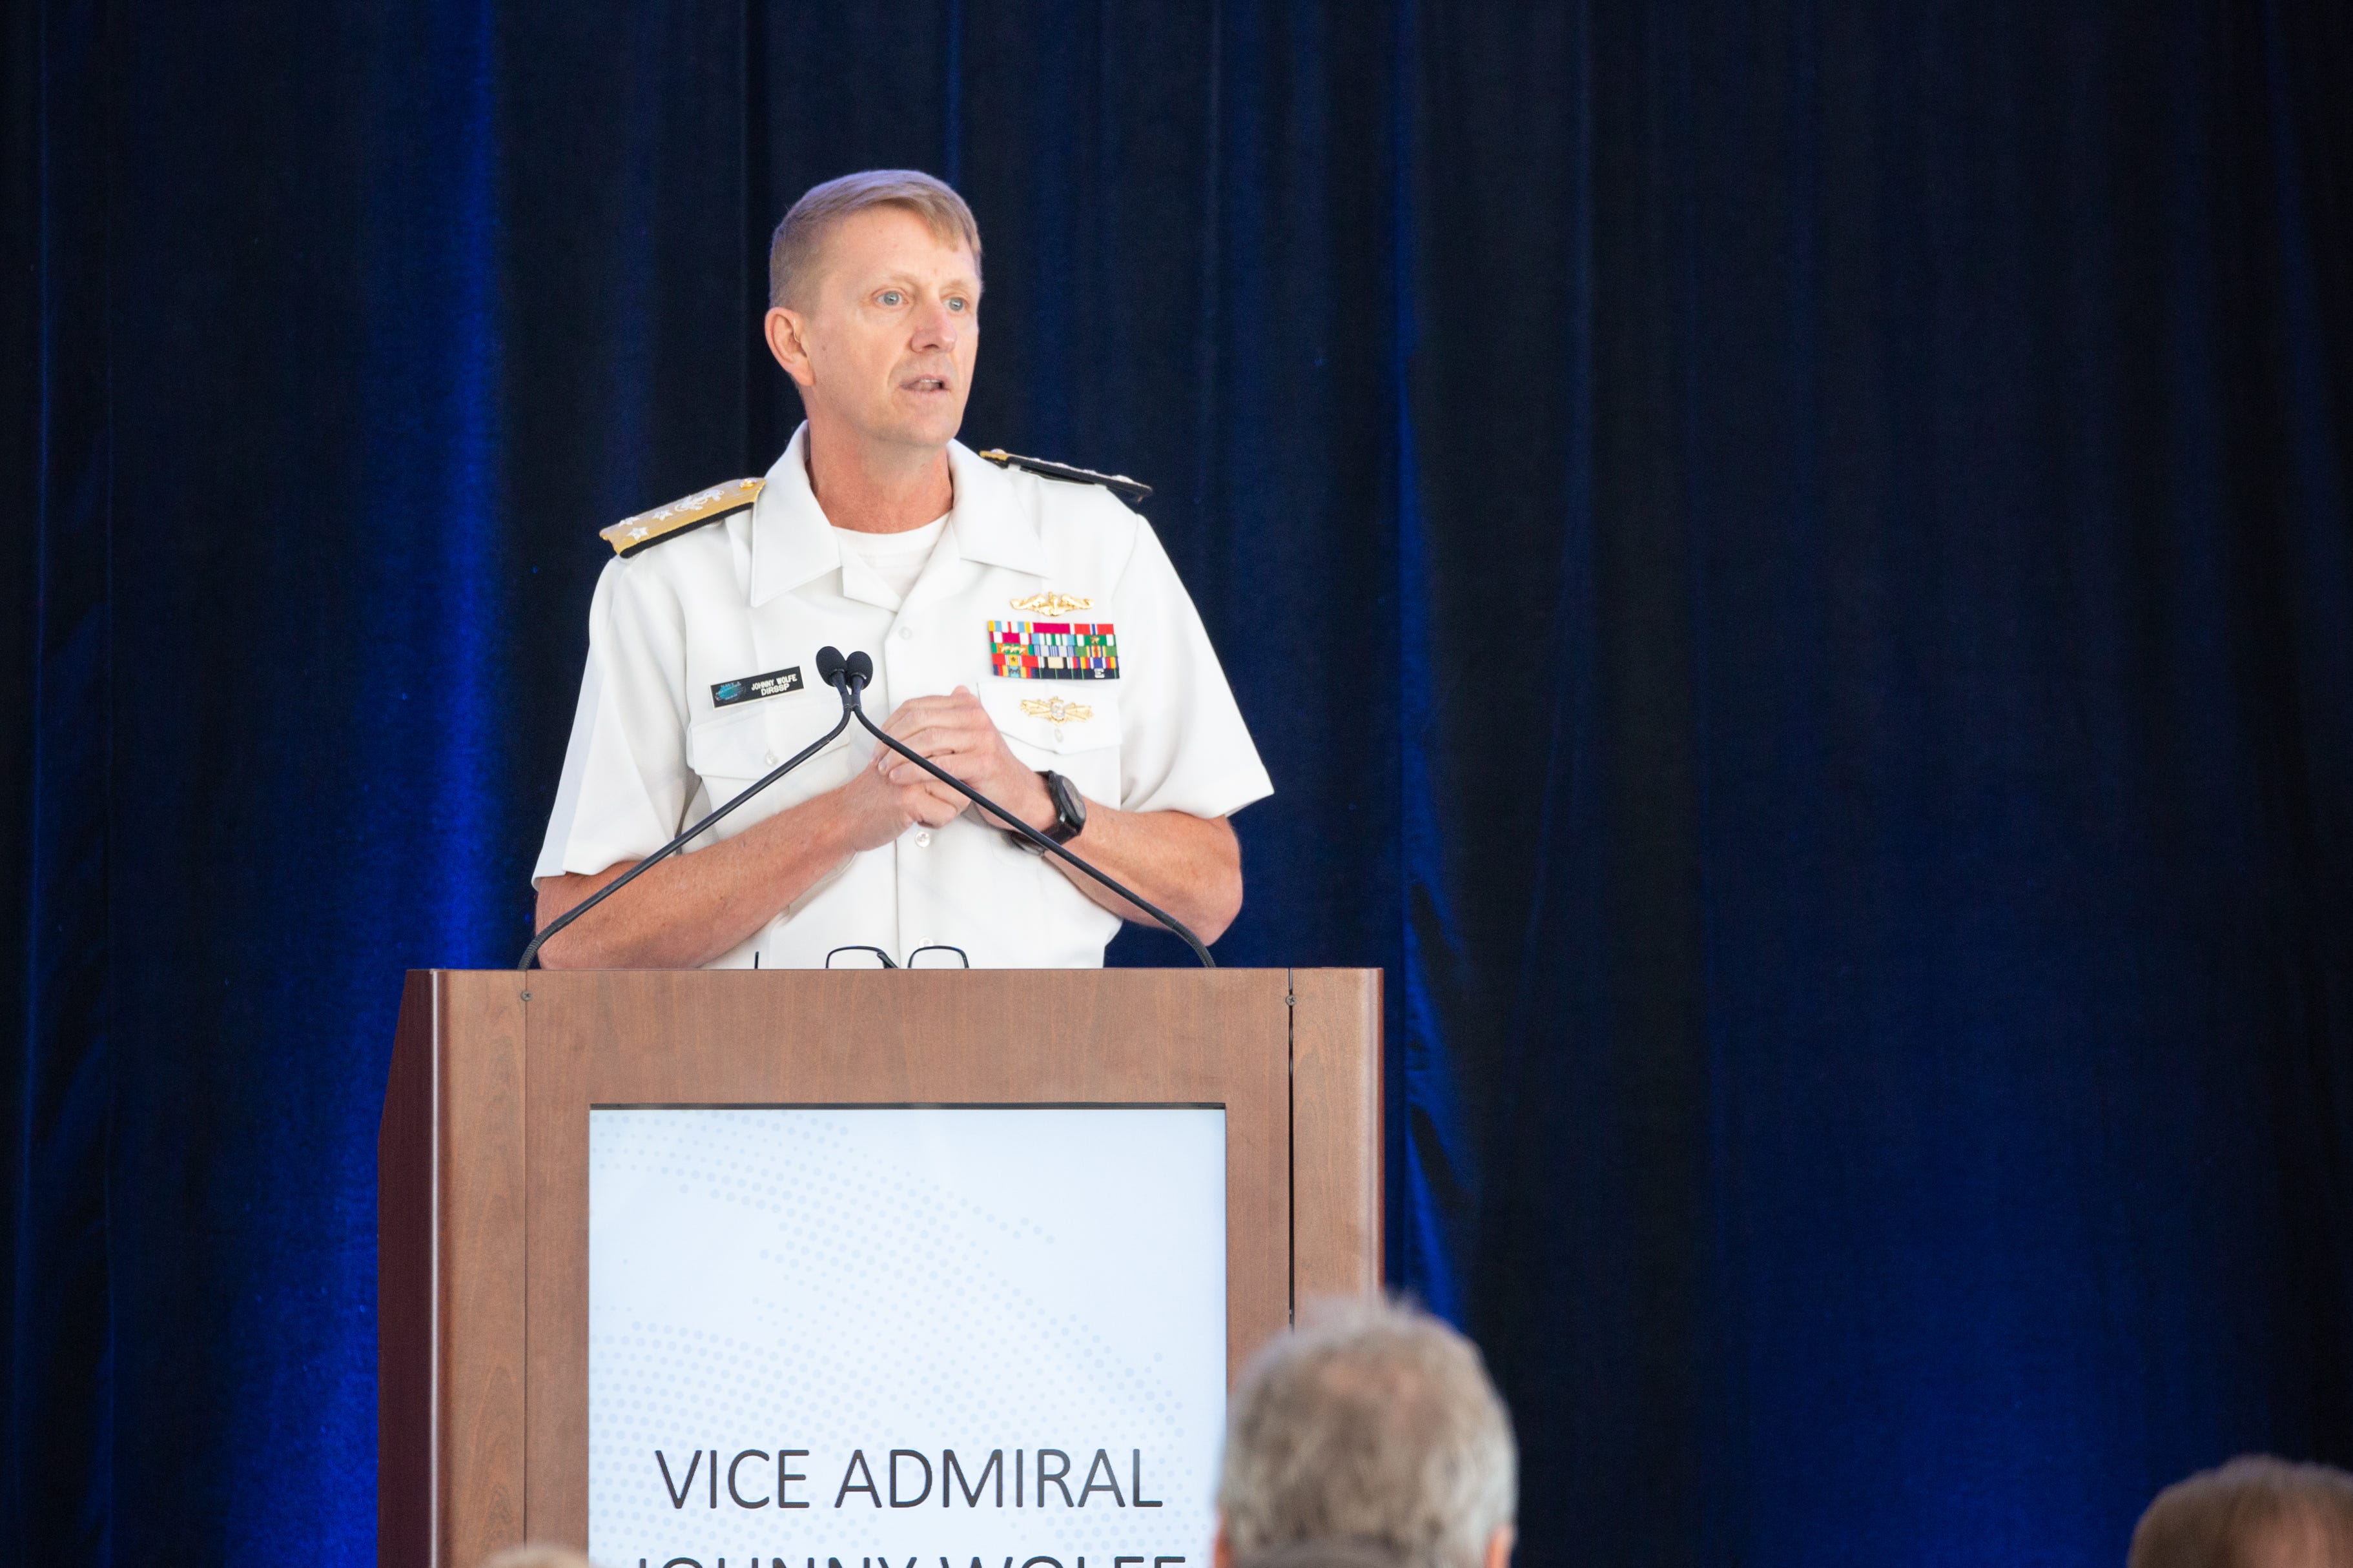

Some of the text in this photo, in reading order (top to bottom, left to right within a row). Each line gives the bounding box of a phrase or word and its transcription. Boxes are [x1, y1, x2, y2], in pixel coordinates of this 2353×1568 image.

[751, 679, 774, 691] JOHNNY
[776, 674, 797, 684] WOLFE
[761, 684, 790, 696] DIRSSP
[654, 1449, 1164, 1509] VICE ADMIRAL
